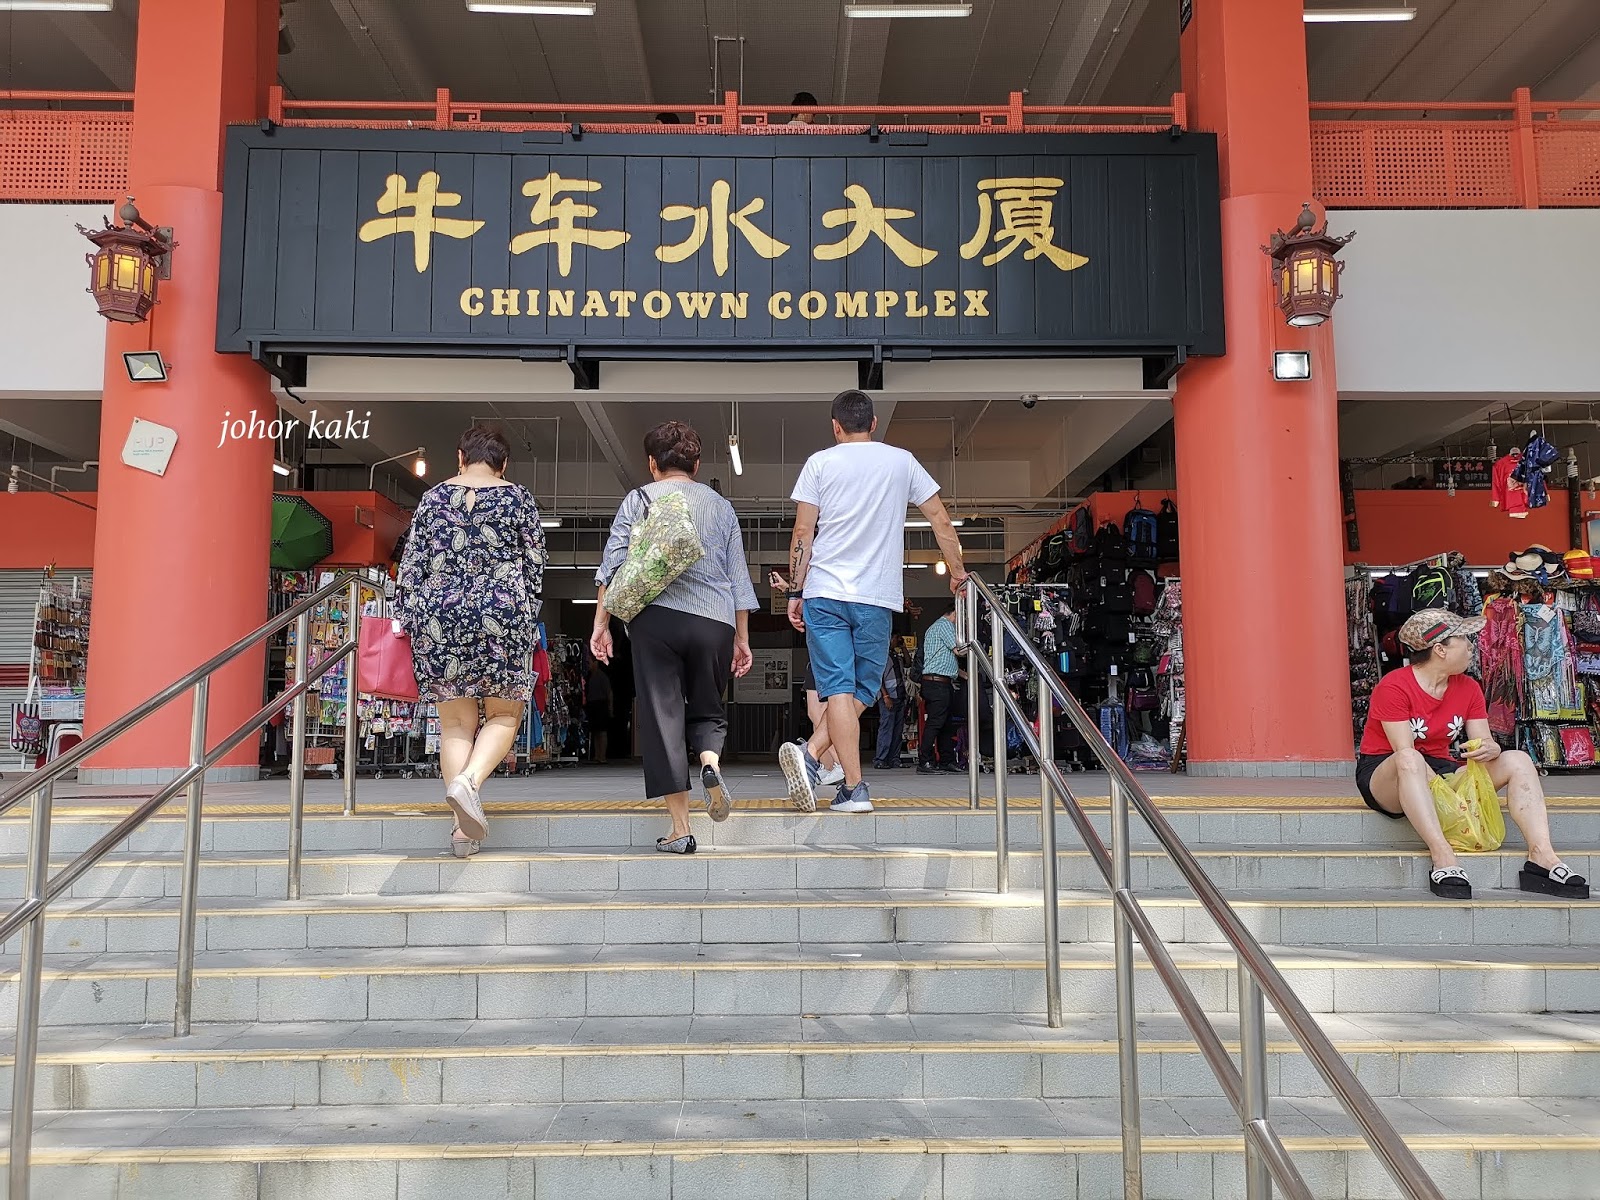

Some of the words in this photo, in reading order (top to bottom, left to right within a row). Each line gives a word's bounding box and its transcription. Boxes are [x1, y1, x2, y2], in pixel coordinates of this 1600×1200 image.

[358, 171, 1090, 277] 牛车水大厦
[459, 287, 750, 320] CHINATOWN
[767, 289, 990, 320] COMPLEX
